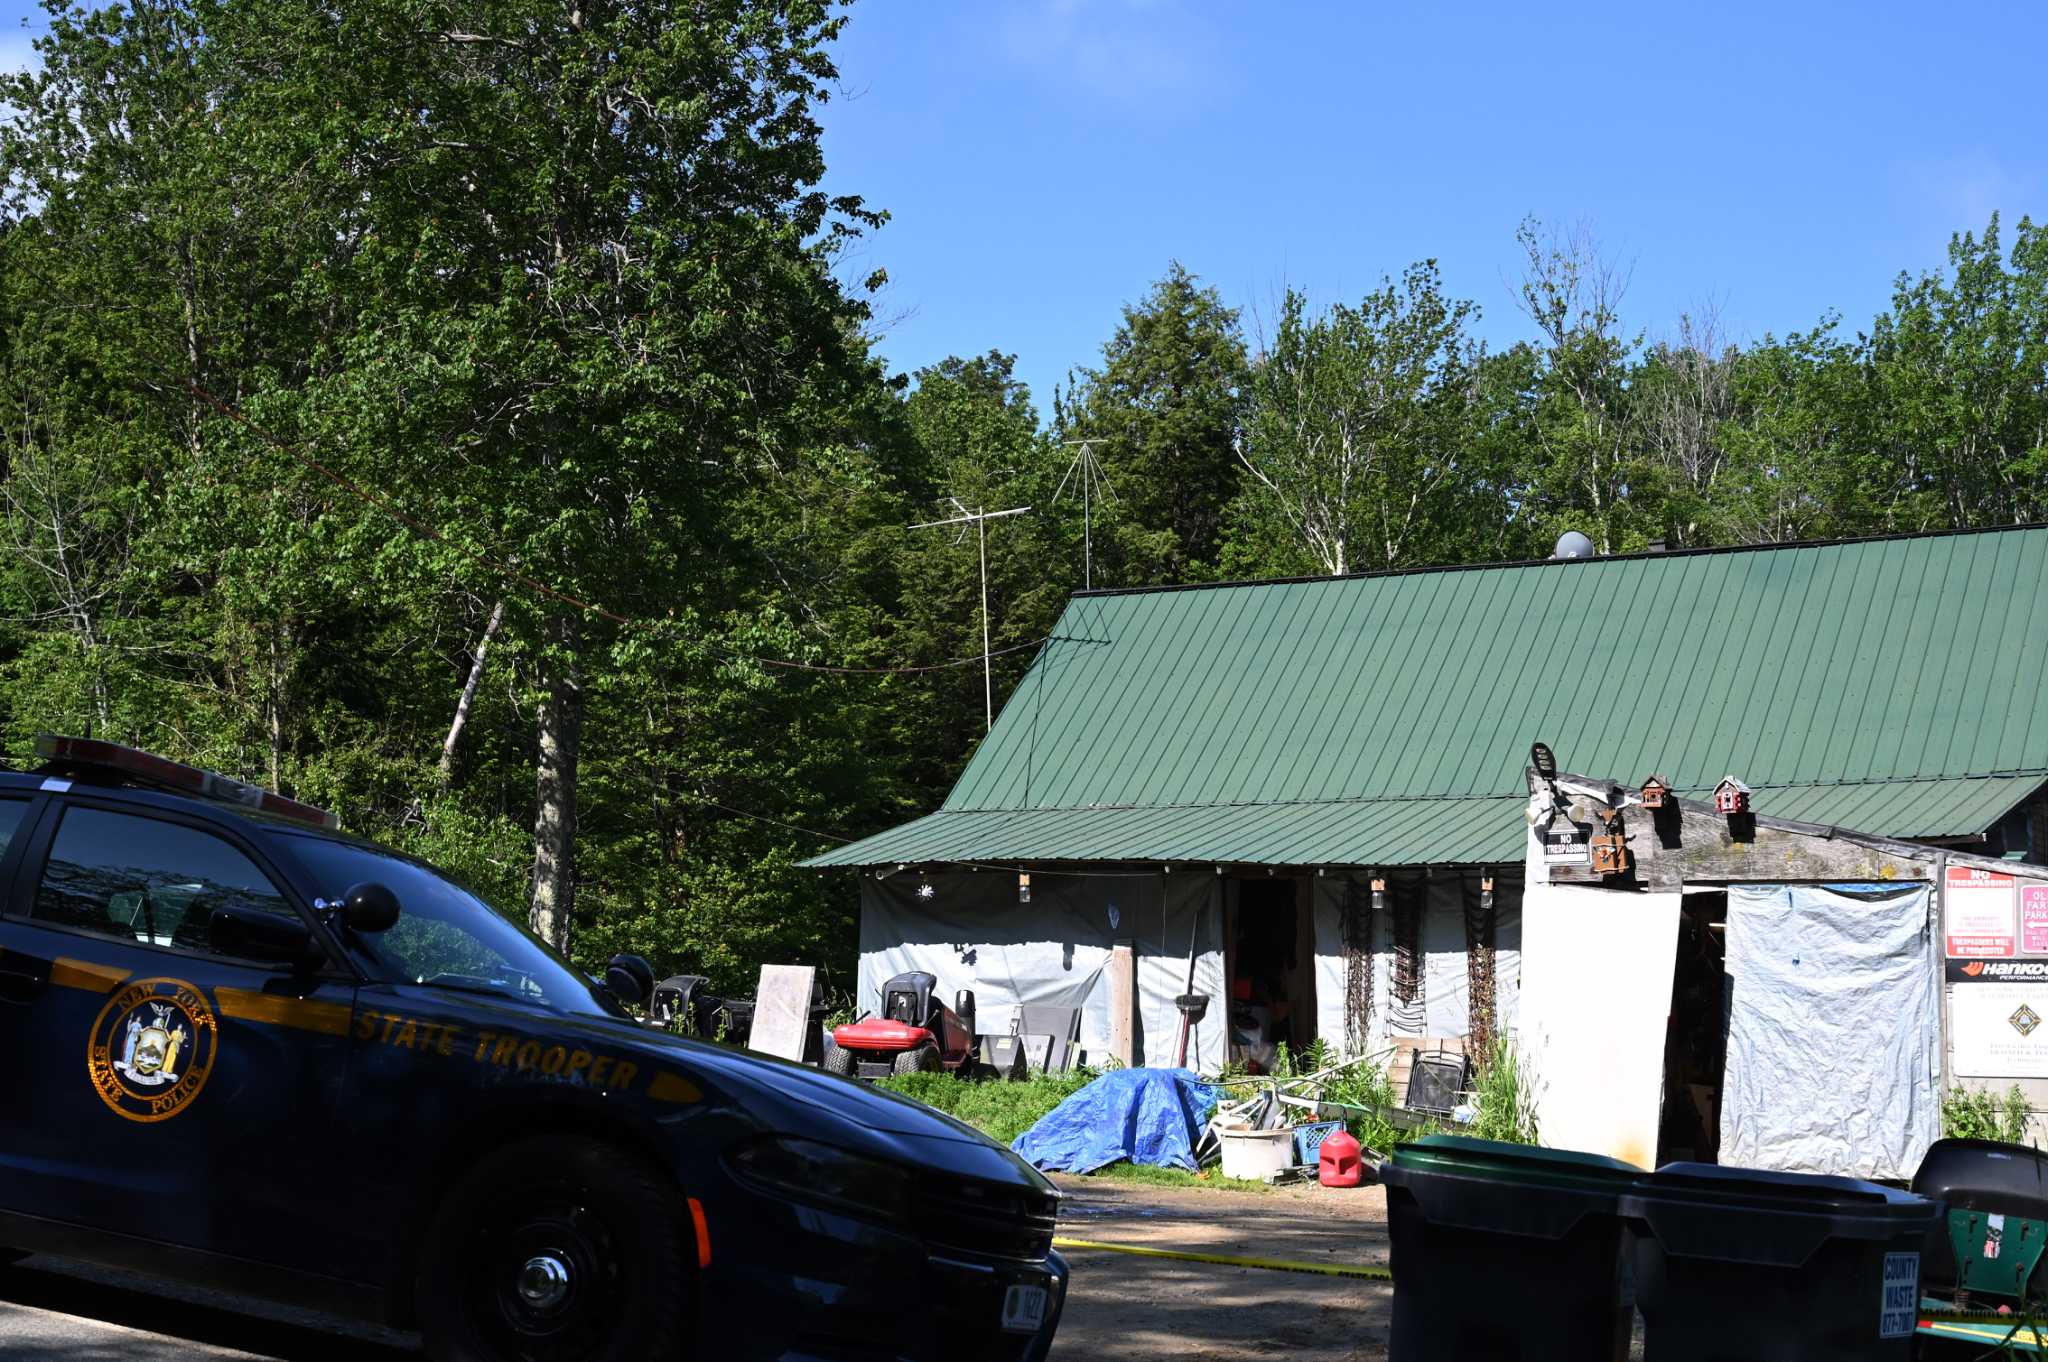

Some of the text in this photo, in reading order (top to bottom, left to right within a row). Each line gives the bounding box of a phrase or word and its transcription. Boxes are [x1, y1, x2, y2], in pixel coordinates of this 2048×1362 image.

[1560, 834, 1572, 843] NO
[1547, 843, 1587, 854] TRESPASSING
[1970, 870, 1991, 880] NO
[2033, 891, 2048, 901] OL
[2026, 901, 2048, 910] FAR
[2025, 911, 2048, 920] PARK
[1995, 938, 2010, 946] WILL
[119, 983, 210, 1026] NEW YORK
[355, 1010, 639, 1090] STATE TROOPER
[94, 1046, 205, 1114] STATE POLICE
[1884, 1257, 1917, 1280] COUNTY
[1885, 1285, 1914, 1309] WASTE
